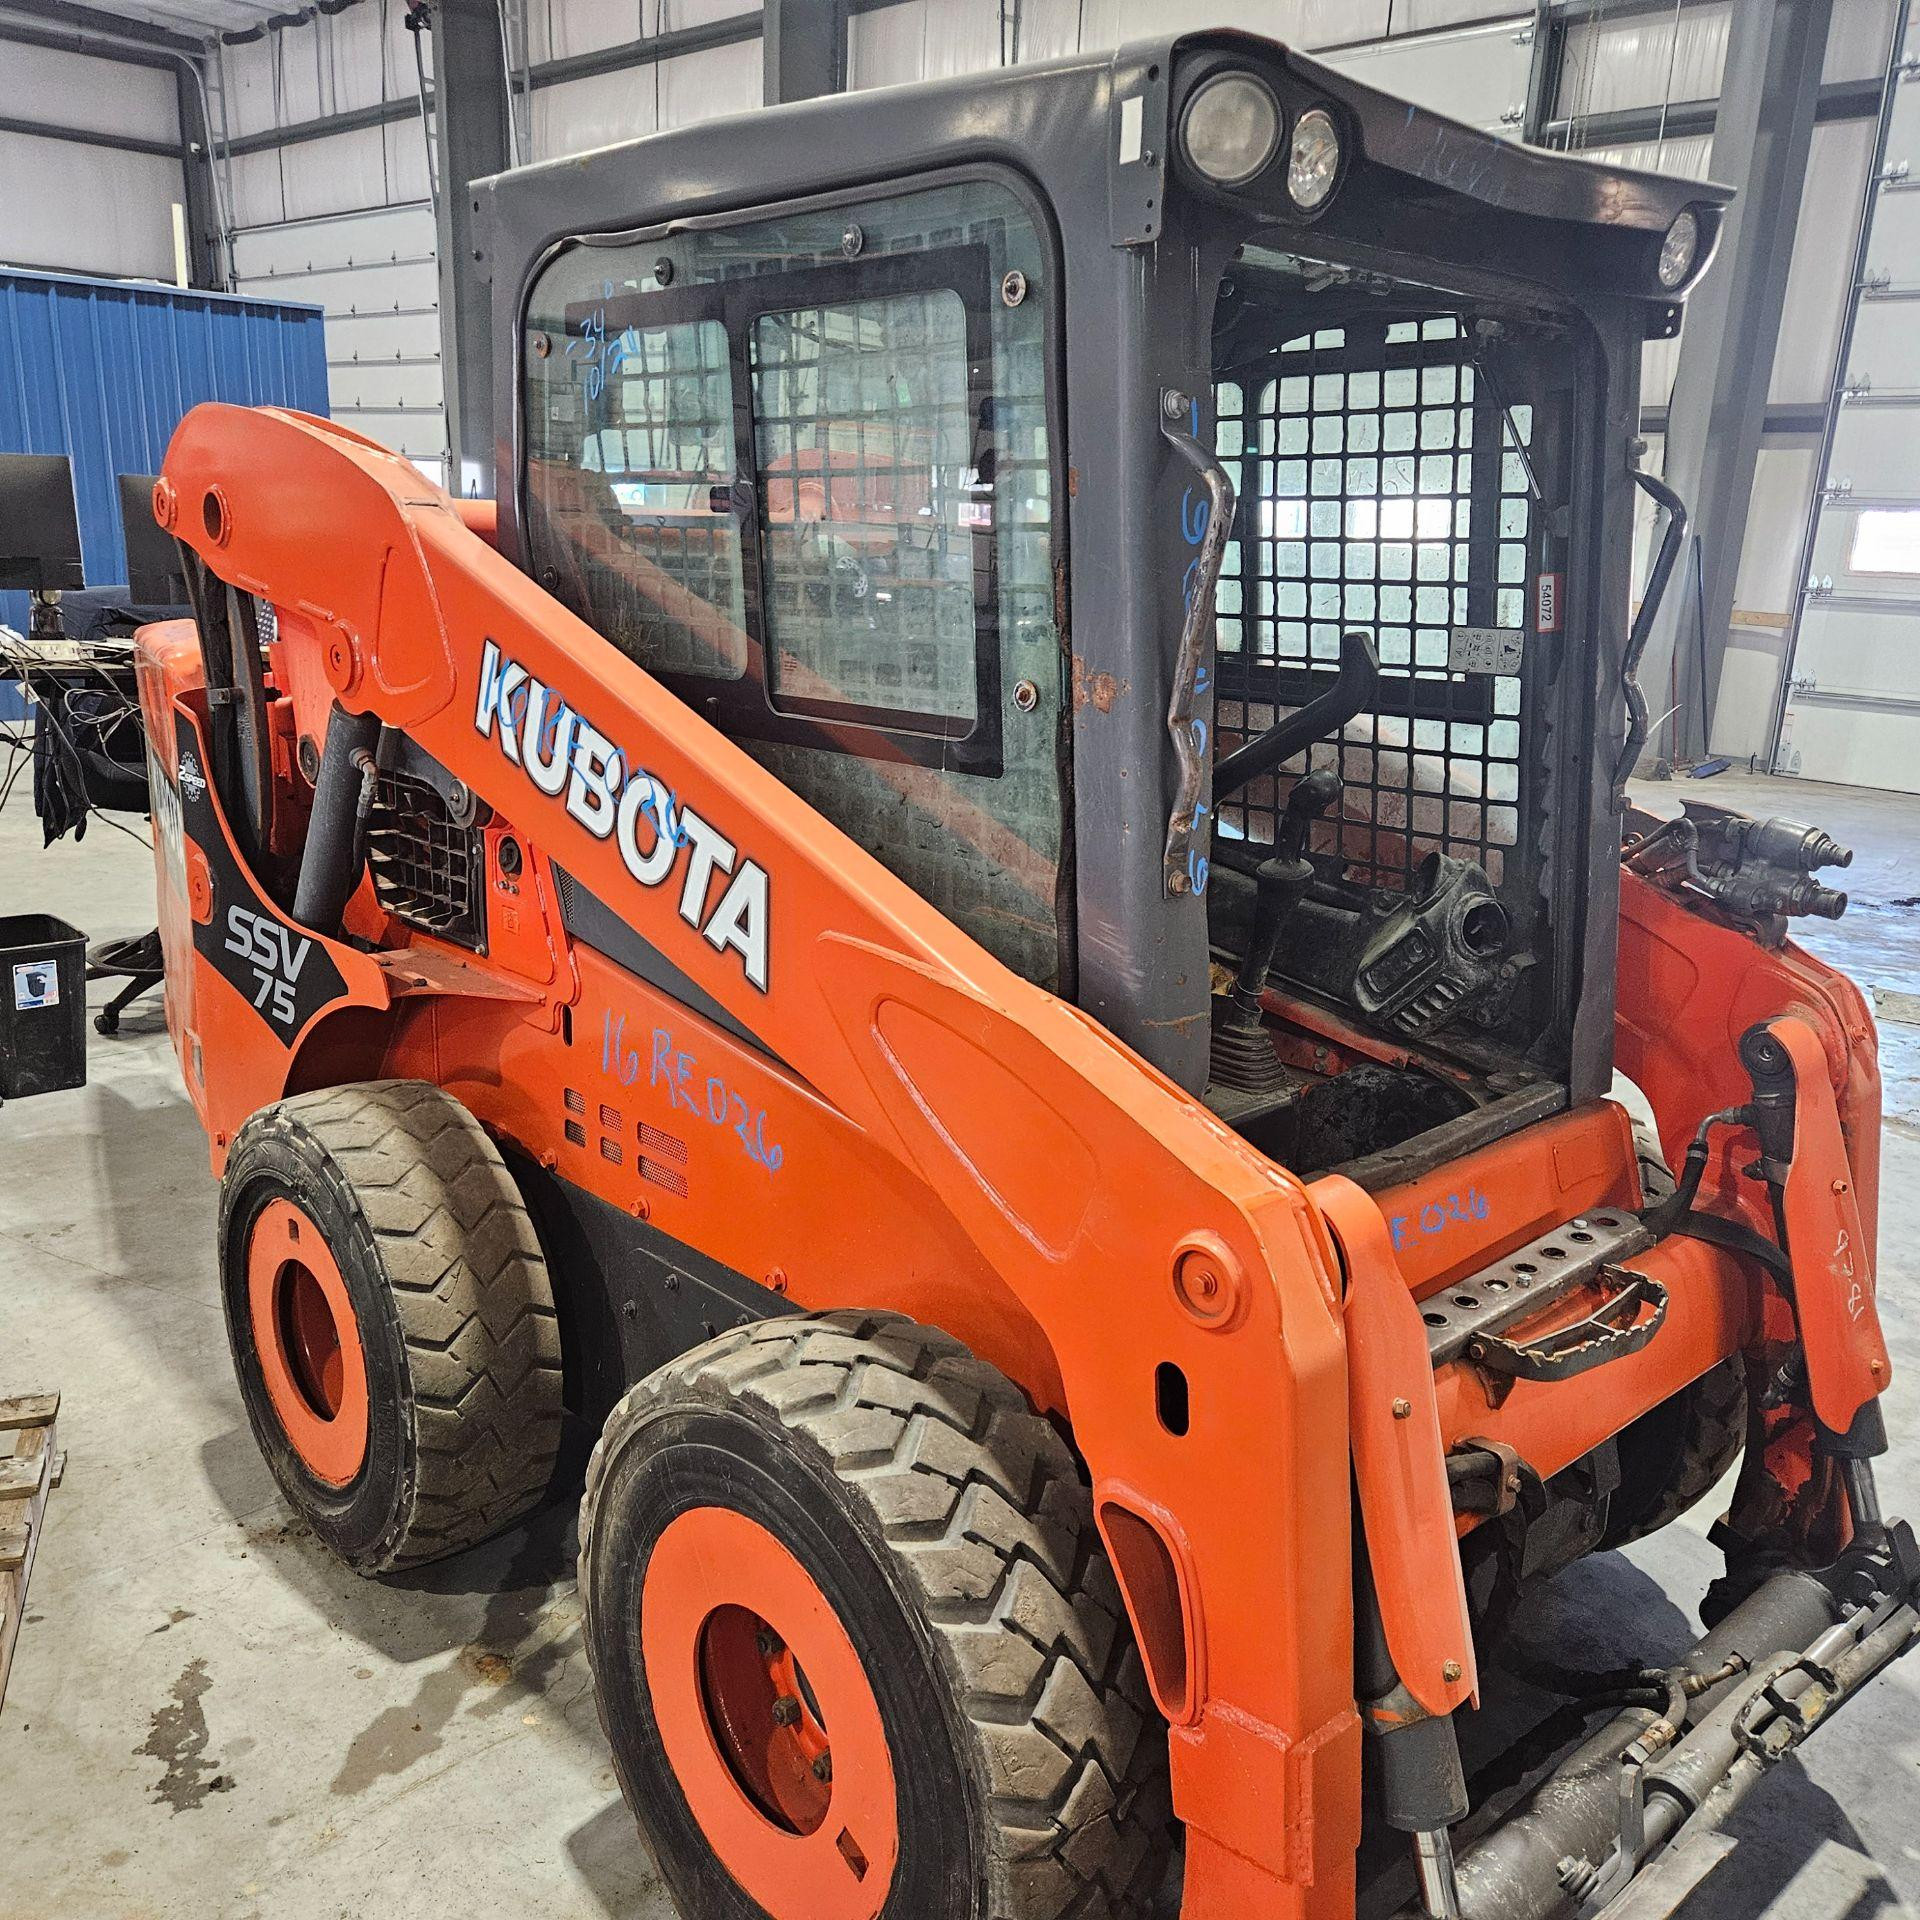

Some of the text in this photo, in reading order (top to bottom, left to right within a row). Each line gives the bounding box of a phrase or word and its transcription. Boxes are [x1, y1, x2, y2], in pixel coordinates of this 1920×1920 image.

[1541, 584, 1552, 622] 54072
[475, 639, 769, 994] KUBOTA
[224, 904, 312, 983] SSV
[252, 967, 297, 1025] 75
